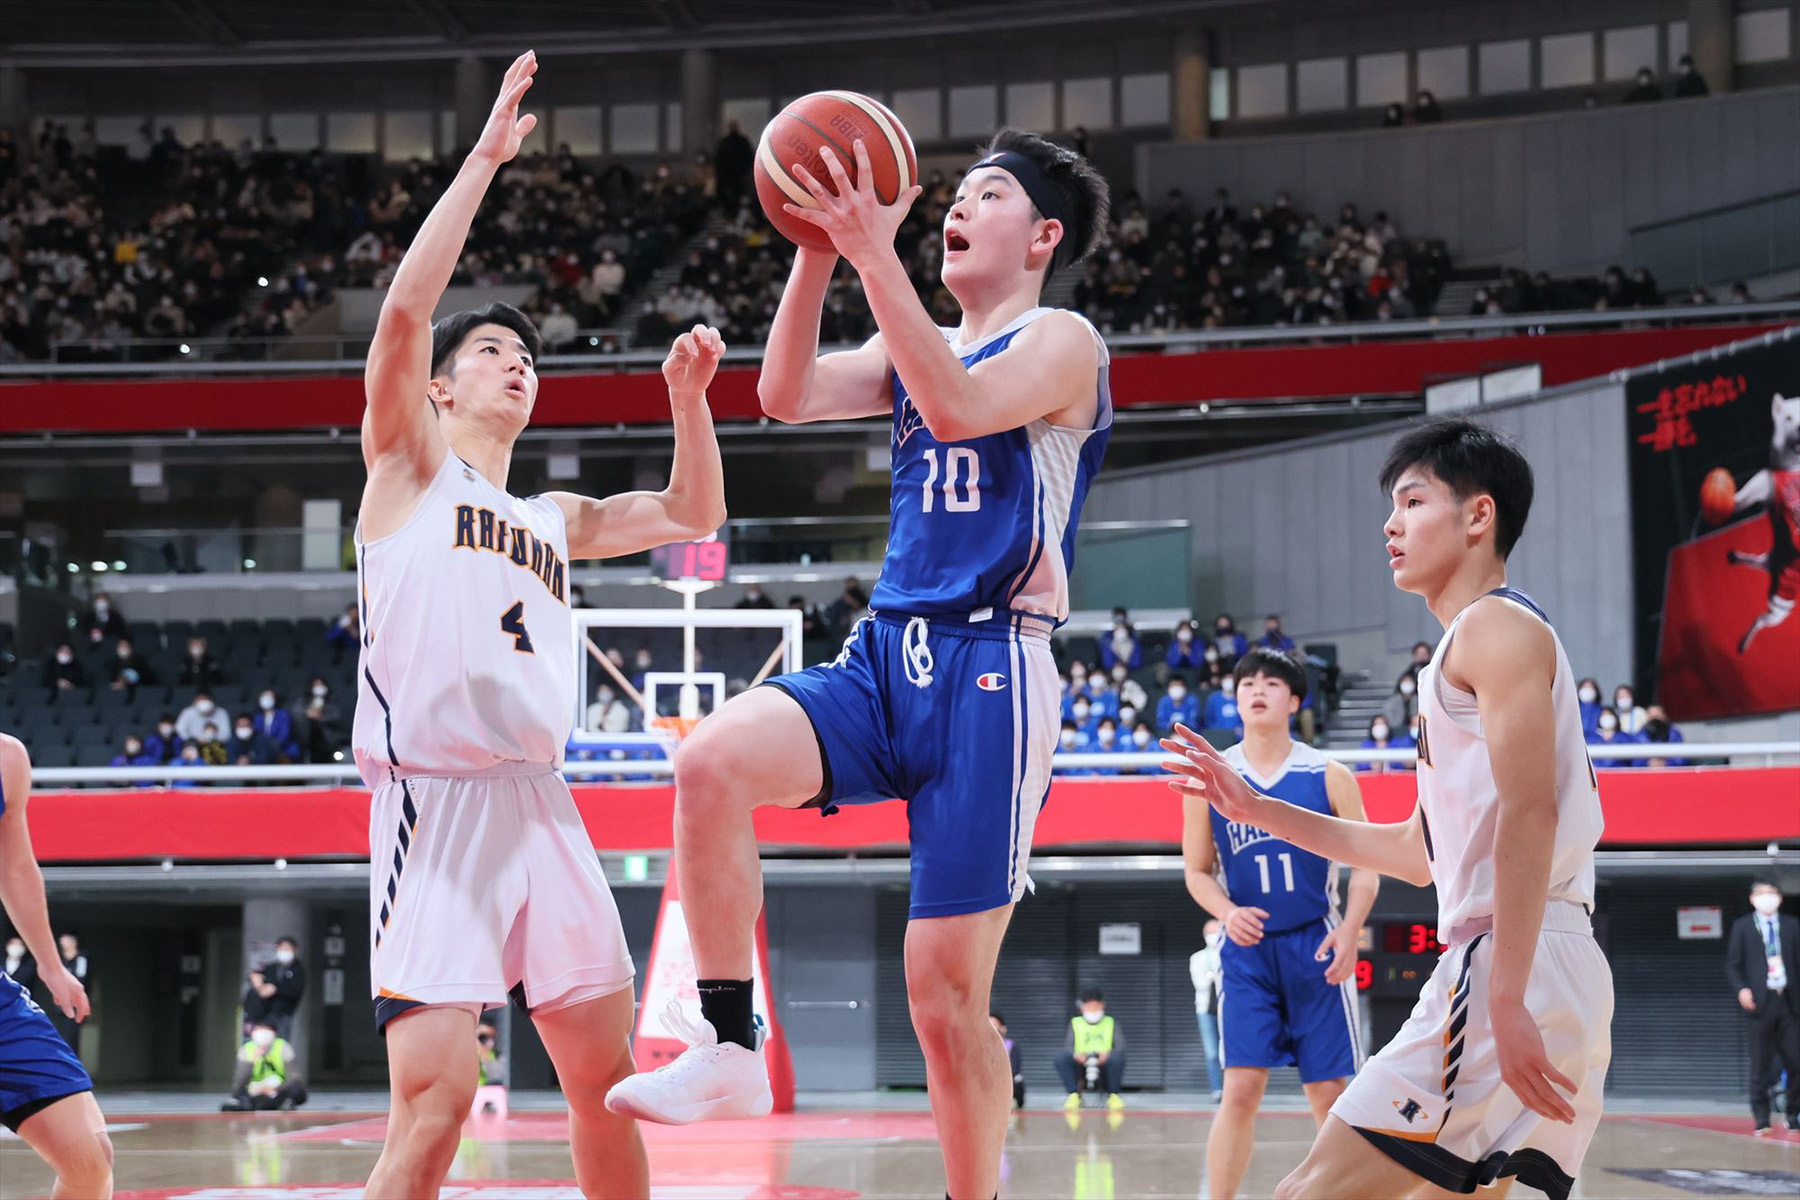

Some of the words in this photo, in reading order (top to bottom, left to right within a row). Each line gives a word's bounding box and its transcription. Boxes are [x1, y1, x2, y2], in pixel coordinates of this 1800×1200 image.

[922, 447, 981, 513] 10
[683, 541, 727, 580] 19
[500, 599, 537, 655] 4
[1254, 853, 1295, 894] 11
